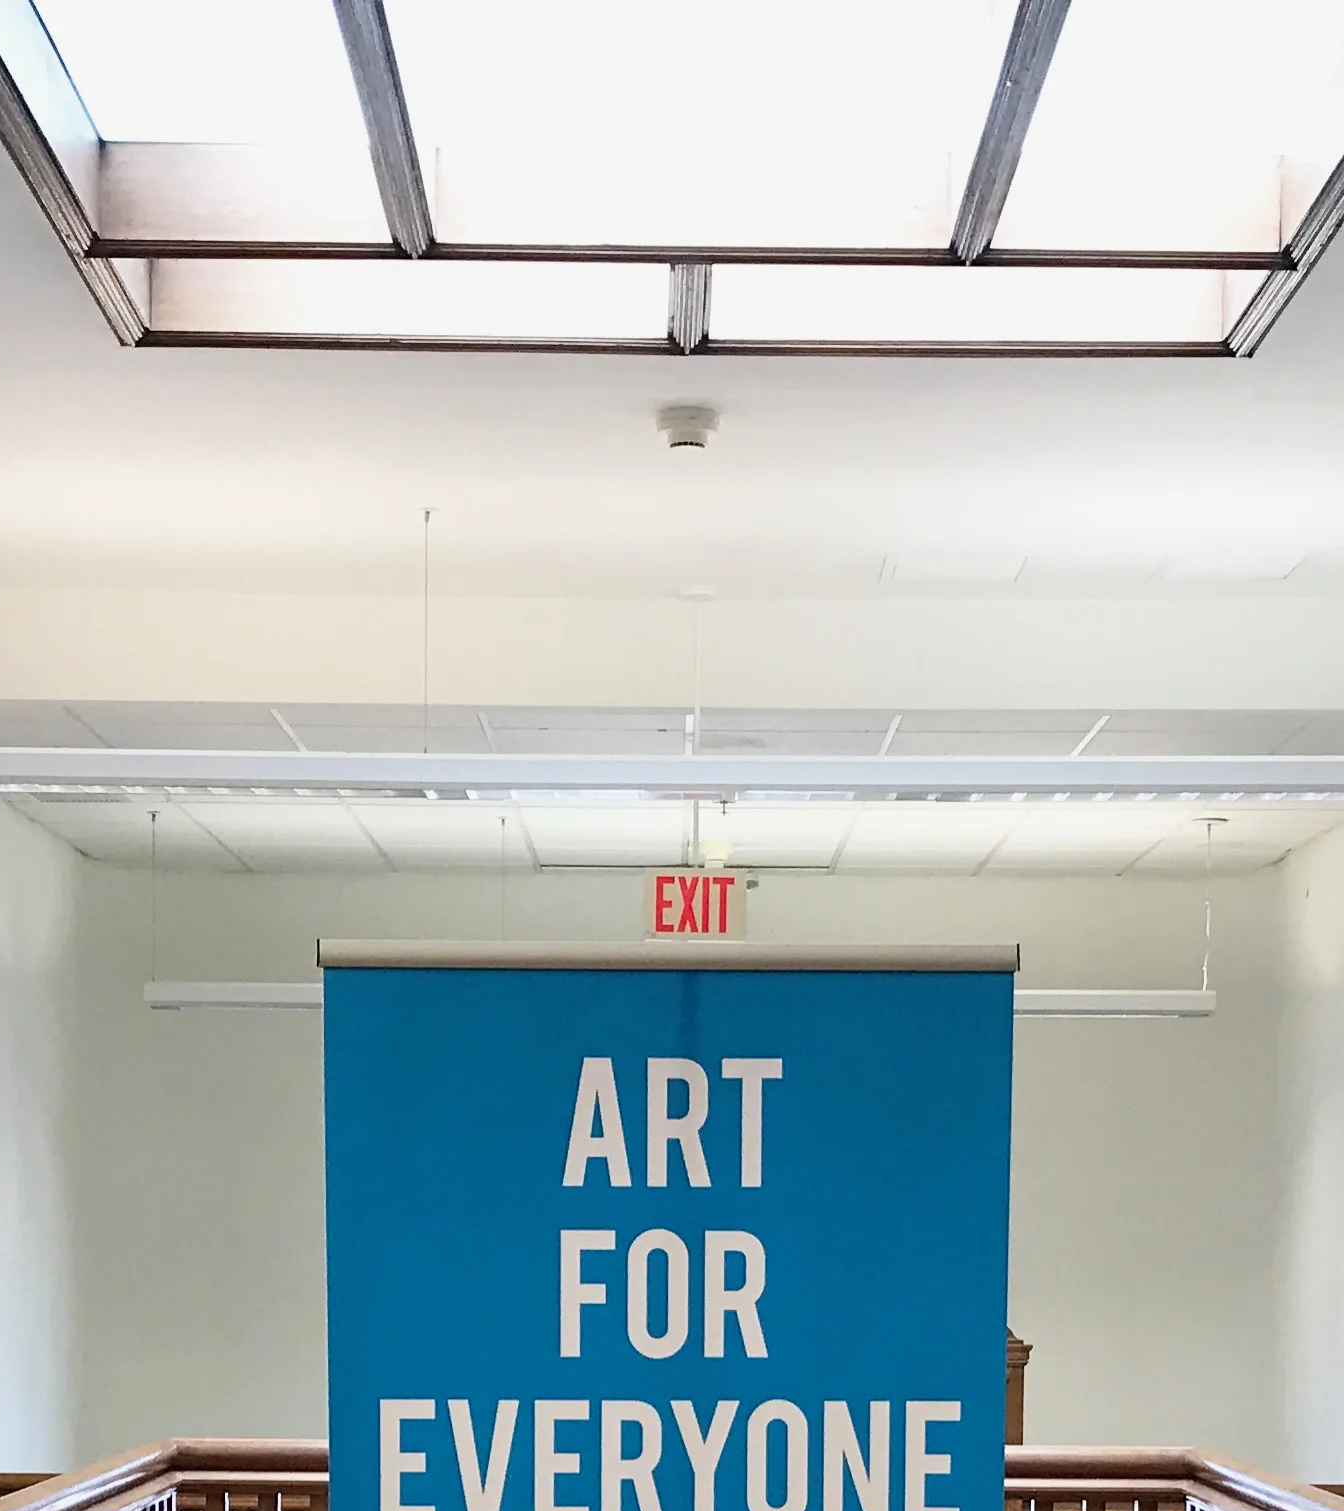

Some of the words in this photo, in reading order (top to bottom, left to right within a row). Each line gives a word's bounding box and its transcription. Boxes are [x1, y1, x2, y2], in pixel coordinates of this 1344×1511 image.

[654, 874, 736, 934] EXIT
[562, 1057, 783, 1188] ART
[559, 1228, 769, 1360] FOR
